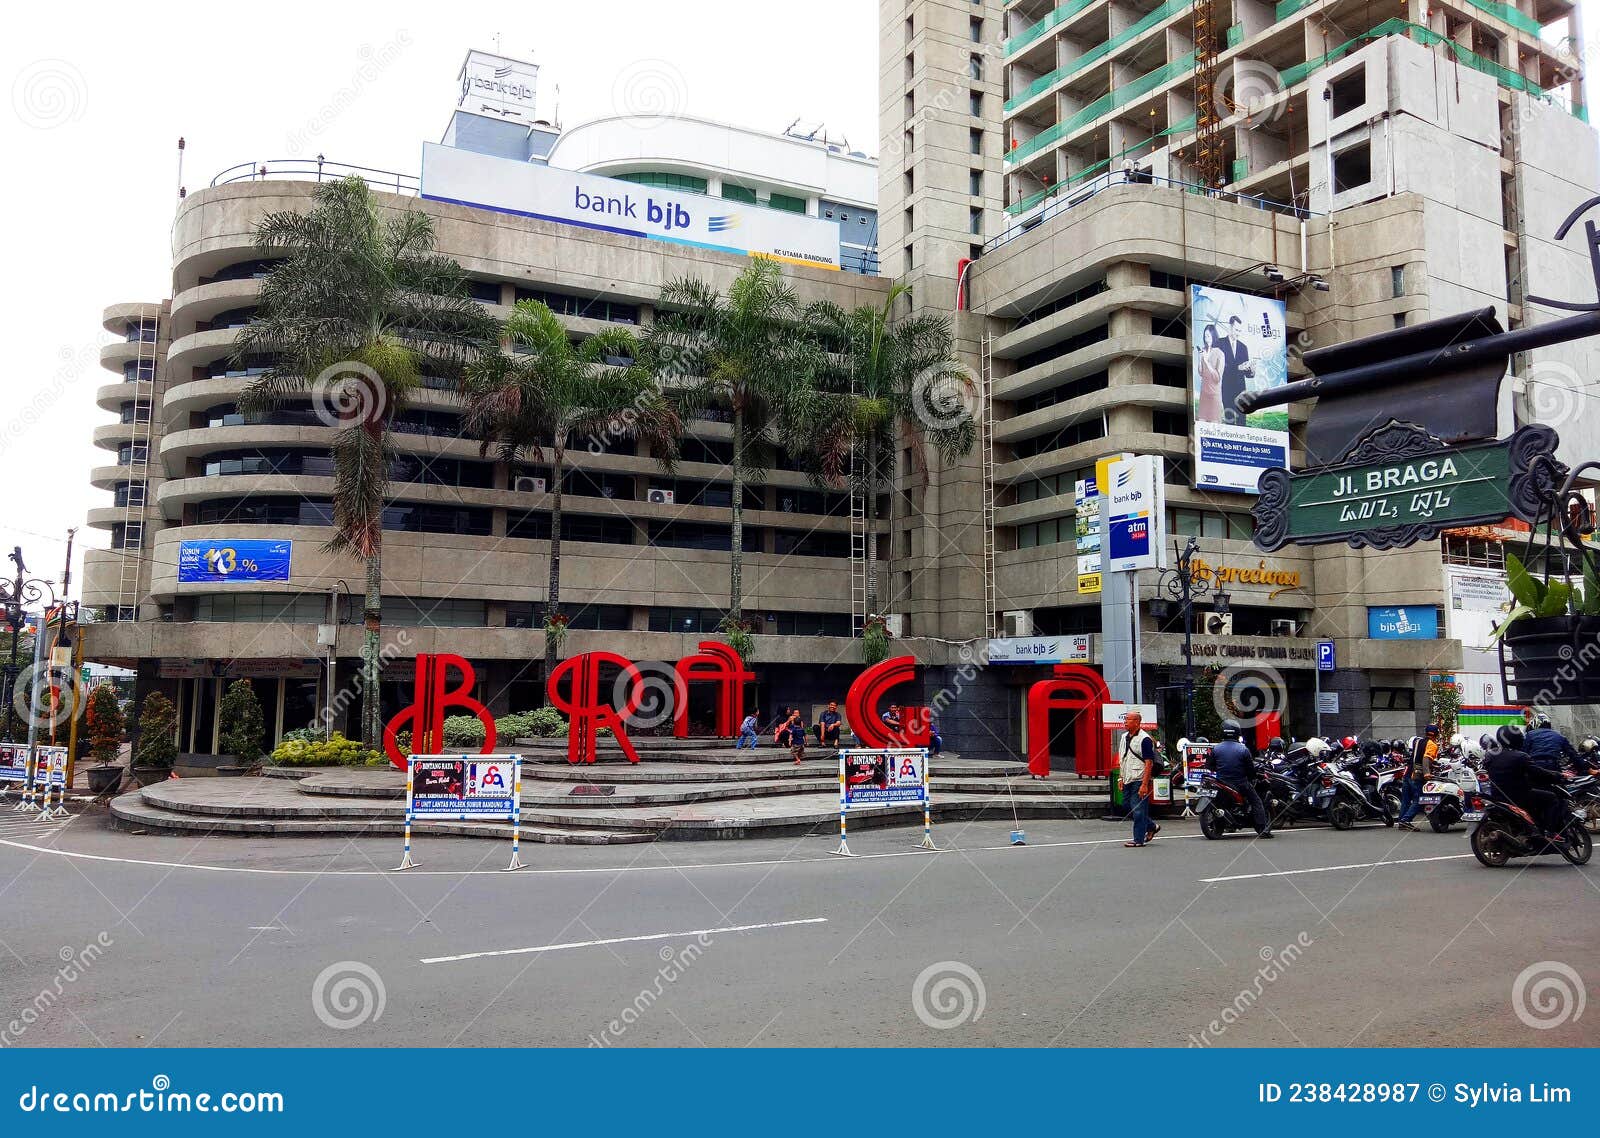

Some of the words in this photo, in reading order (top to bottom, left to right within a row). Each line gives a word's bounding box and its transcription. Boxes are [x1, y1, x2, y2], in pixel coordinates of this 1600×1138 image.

[474, 75, 507, 93] bank
[575, 186, 636, 218] bank
[647, 198, 690, 230] bjb
[774, 248, 782, 256] KC
[782, 250, 803, 260] UTAMA
[803, 253, 832, 264] BANDUNG
[1366, 458, 1458, 491] BRAGA
[1113, 495, 1129, 504] bank
[1130, 491, 1142, 501] bjb
[1127, 522, 1146, 533] atm
[1073, 637, 1086, 646] atm
[1016, 645, 1032, 655] bank
[1033, 643, 1046, 655] bjb
[853, 756, 876, 765] BINTANG
